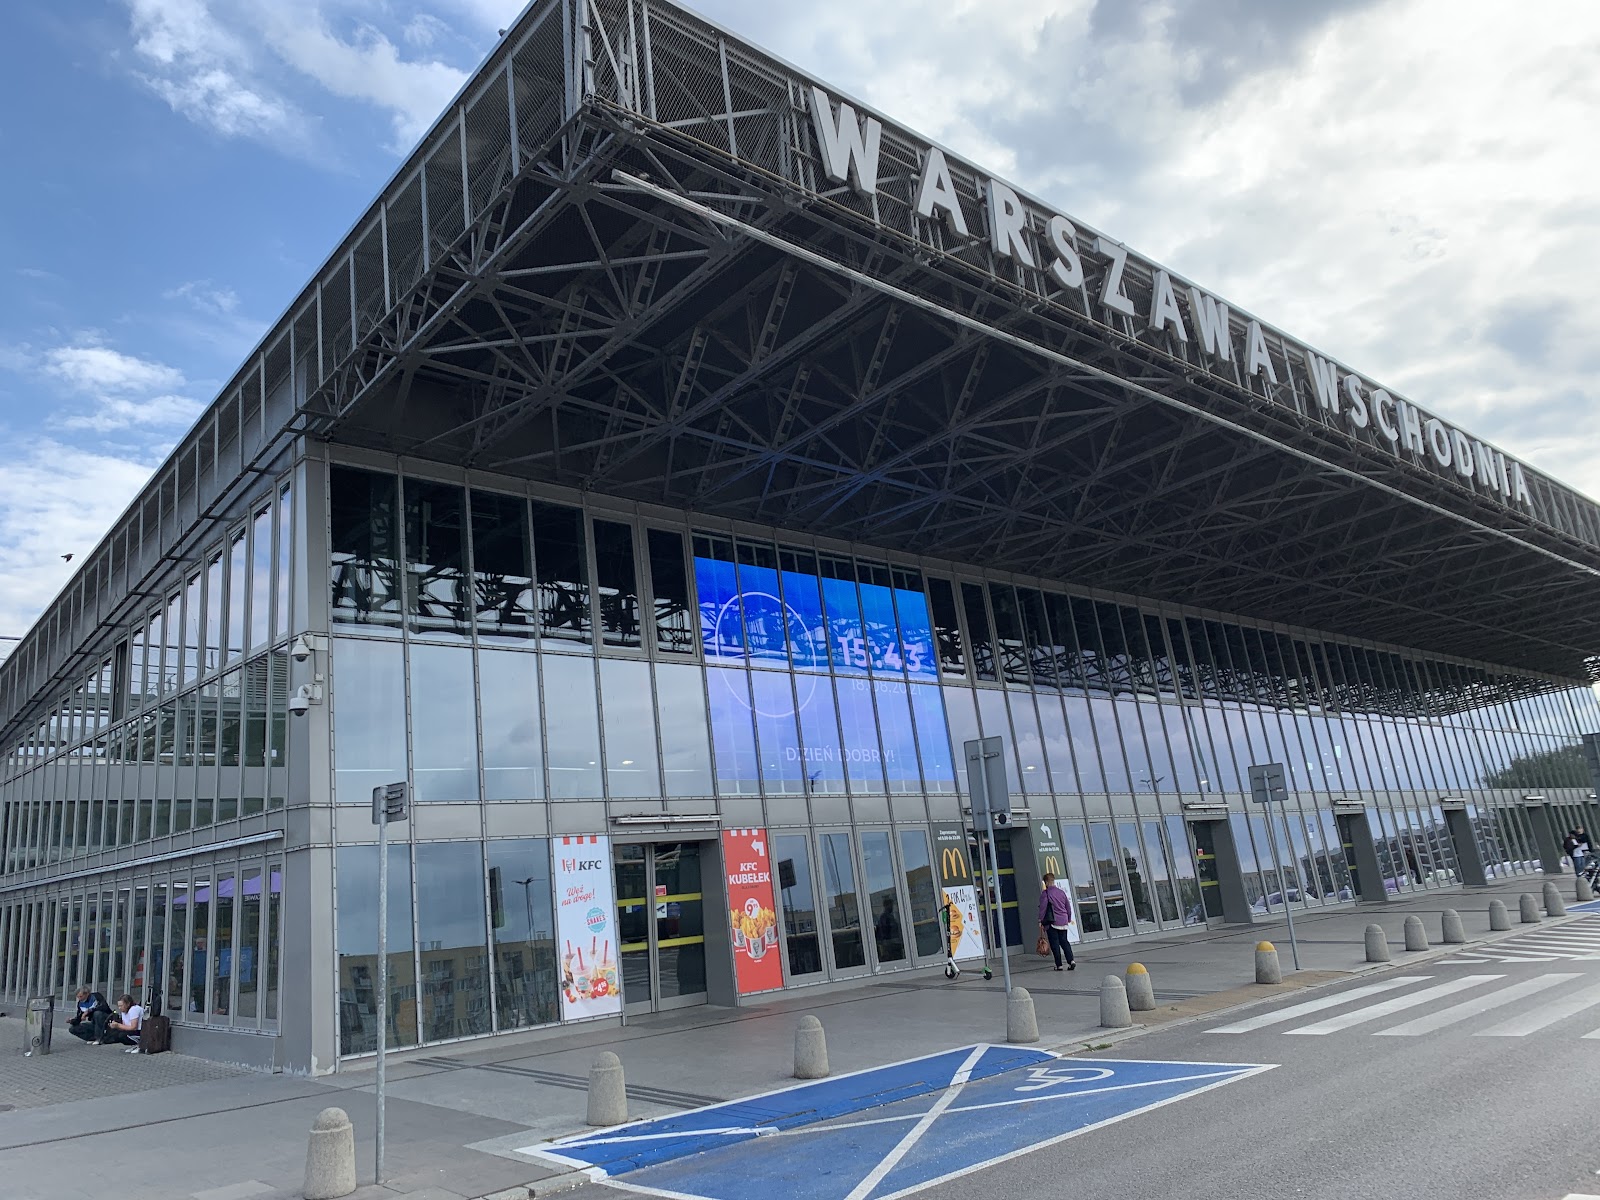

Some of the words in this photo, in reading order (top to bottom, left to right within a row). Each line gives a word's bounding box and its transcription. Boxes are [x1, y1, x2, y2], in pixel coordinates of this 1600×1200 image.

[809, 85, 1278, 385] WARSZAWA
[1303, 349, 1532, 507] WSCHODNIA
[838, 635, 921, 672] 15:43
[785, 745, 834, 762] DZIEŃ
[838, 748, 895, 763] DOBRY!
[578, 860, 601, 871] KFC
[740, 862, 757, 871] KFC
[729, 872, 770, 884] KUBEŁEK
